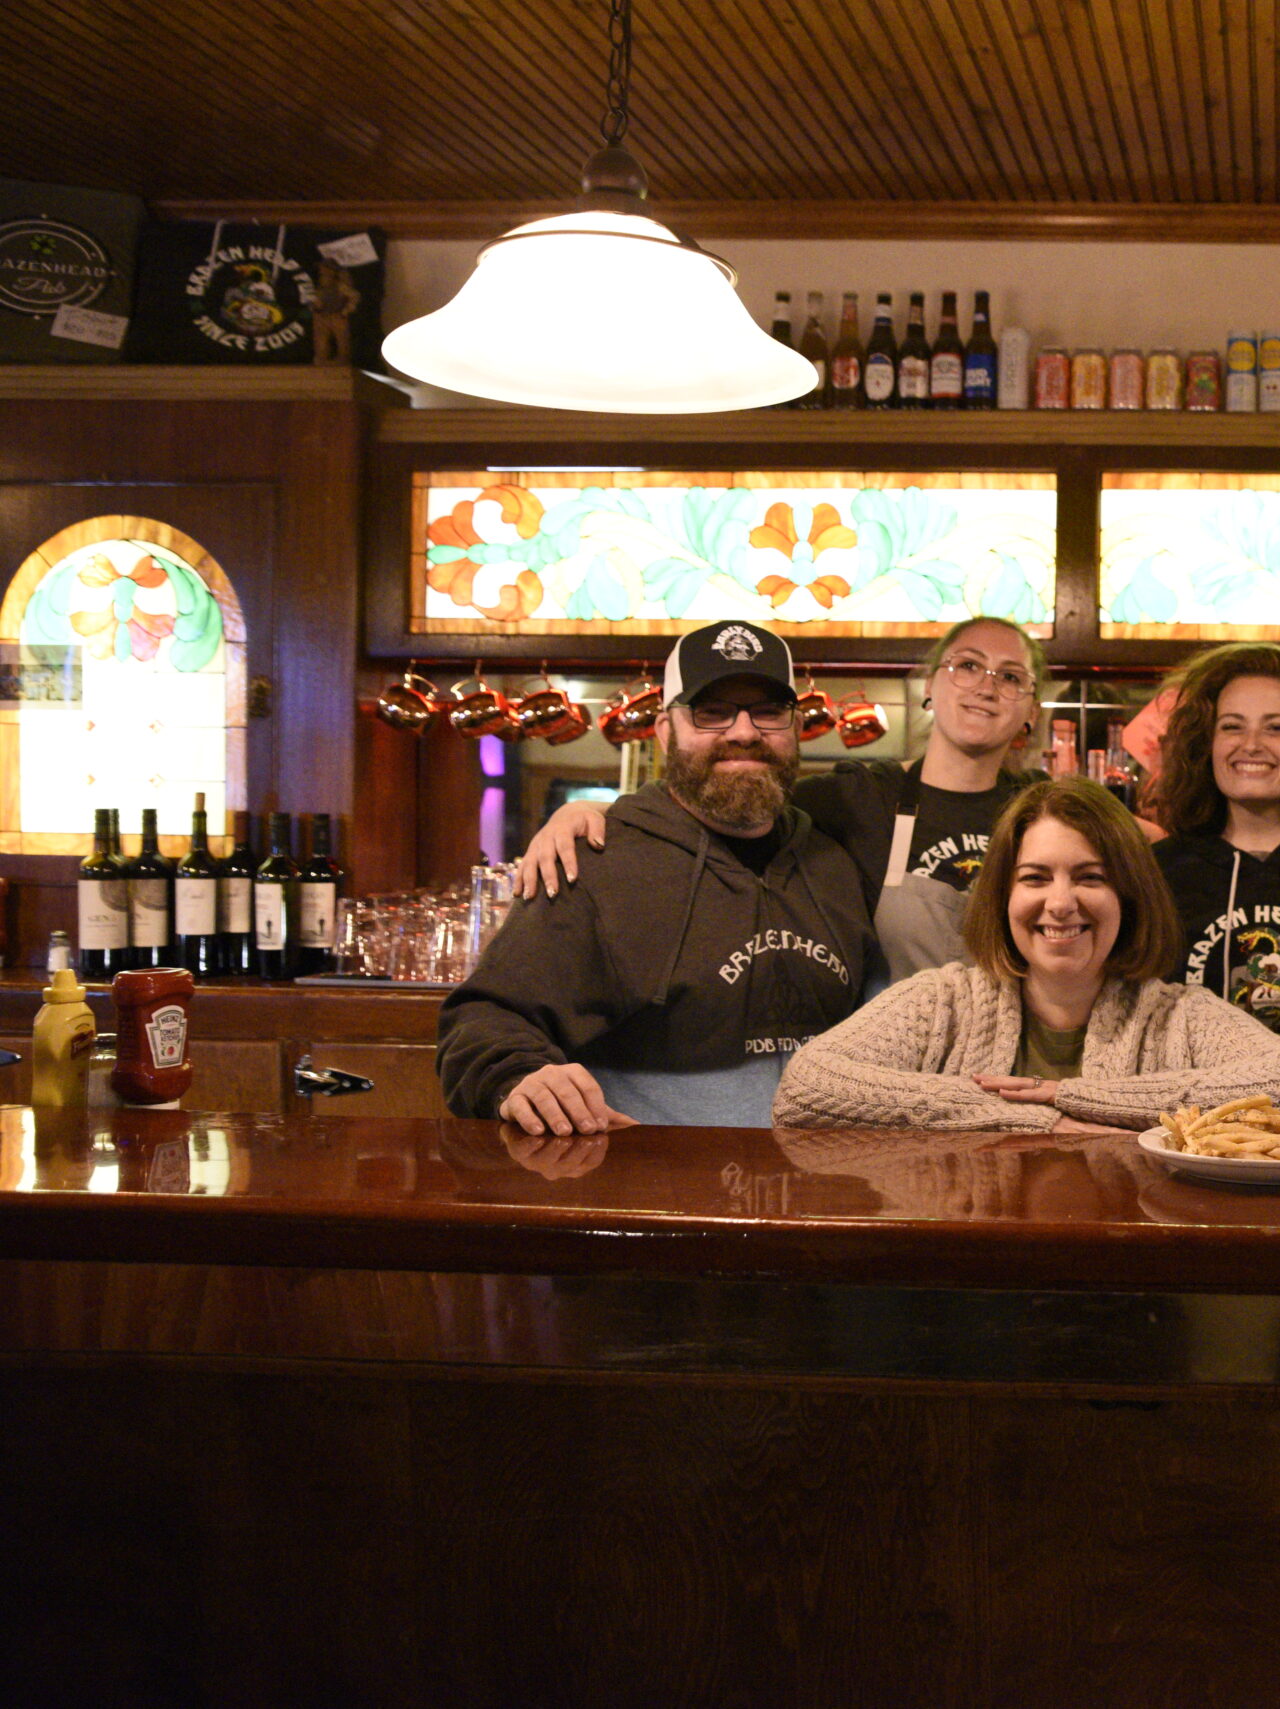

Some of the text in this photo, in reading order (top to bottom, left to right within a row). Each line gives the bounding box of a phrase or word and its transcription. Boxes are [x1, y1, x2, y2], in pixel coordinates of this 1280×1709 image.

[0, 258, 106, 278] AZENHEAD
[911, 833, 990, 878] AZEN HE
[1185, 908, 1249, 985] BRAZEN
[160, 1015, 179, 1024] HEINZ
